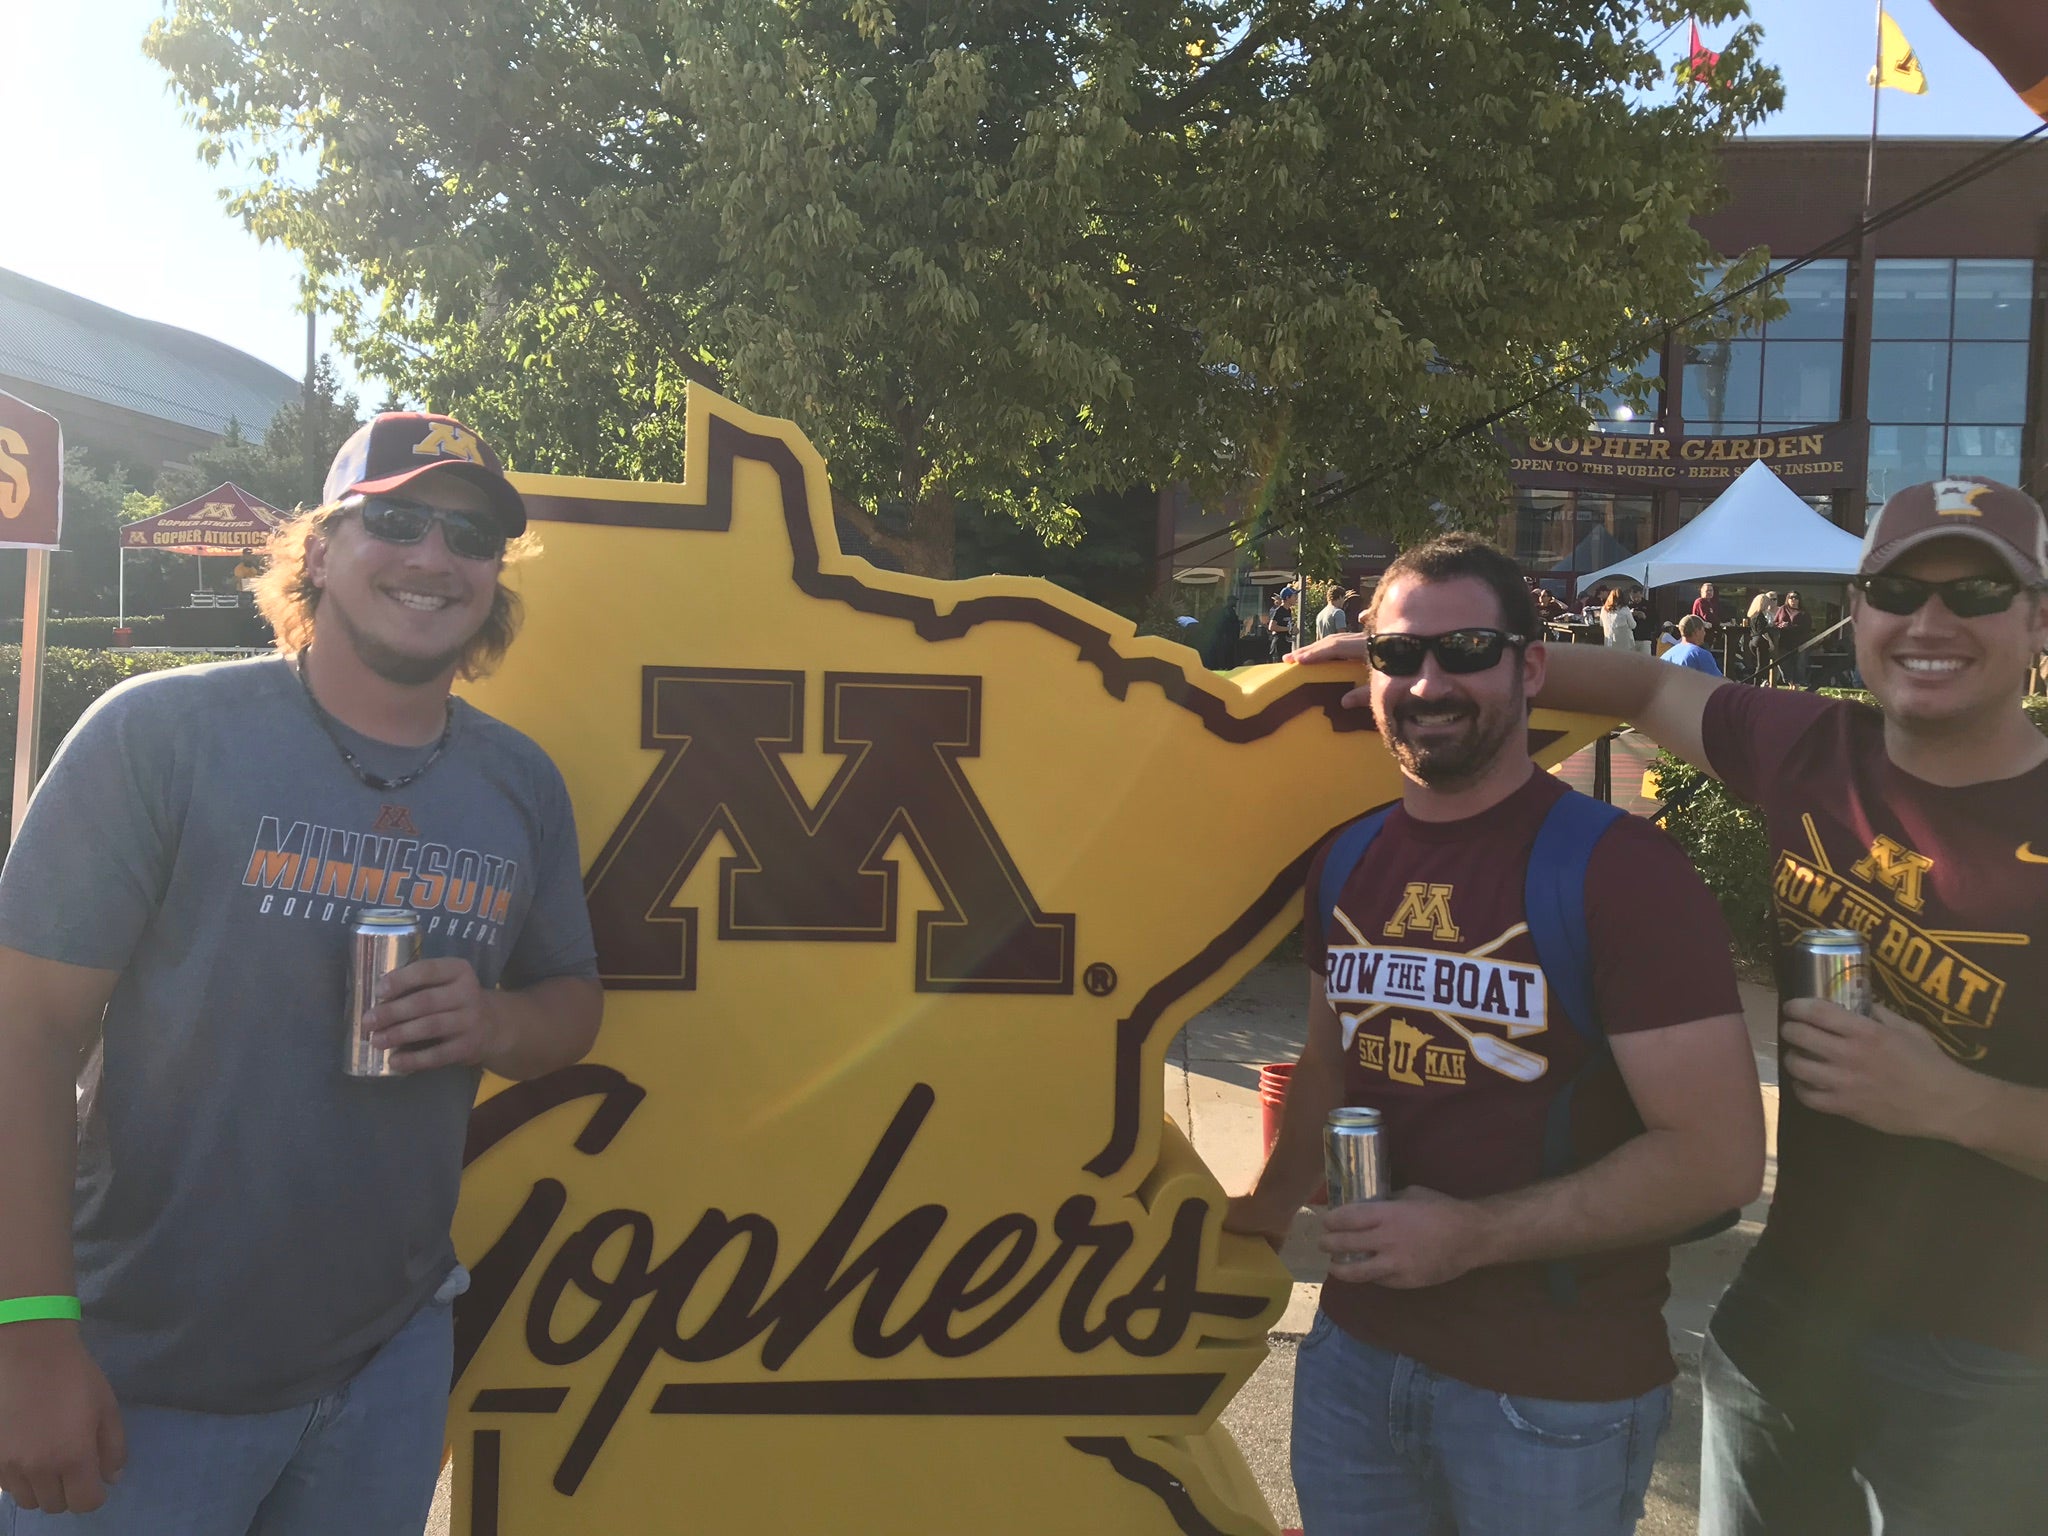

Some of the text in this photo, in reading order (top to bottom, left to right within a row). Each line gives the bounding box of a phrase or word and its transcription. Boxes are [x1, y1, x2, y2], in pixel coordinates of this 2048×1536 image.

[1529, 434, 1824, 461] GOPHER GARDEN
[1510, 458, 1553, 471] OPEN
[1556, 460, 1579, 472] TO
[1582, 462, 1614, 475] THE
[1617, 464, 1676, 478] PUBLIC
[1688, 466, 1731, 478] BEER
[1785, 461, 1844, 475] INSIDE
[153, 529, 202, 545] GOPHER
[204, 530, 267, 545] ATHLETICS
[157, 518, 254, 528] GOPHER ATHLETICS
[259, 894, 352, 925] GOLDE
[1774, 856, 1991, 1017] ROW THE BOAT
[1325, 952, 1536, 1019] ROW THE BOAT
[1358, 1038, 1467, 1078] SKI U MAH
